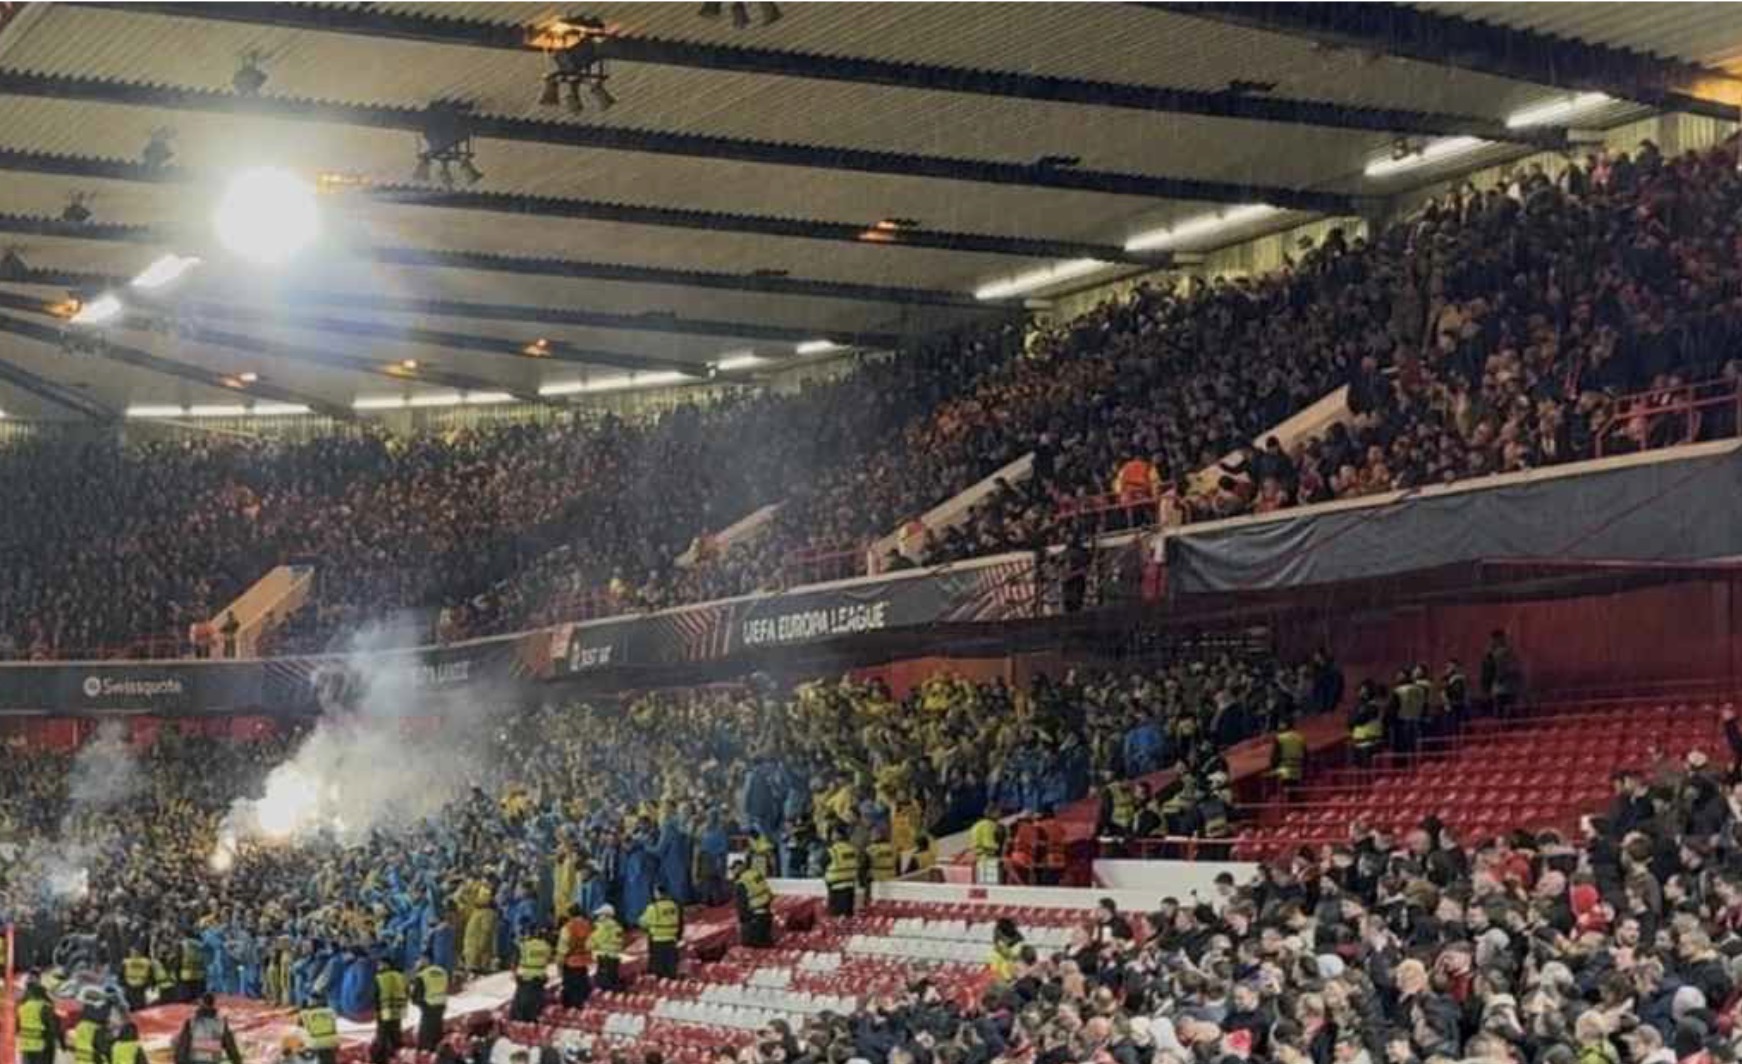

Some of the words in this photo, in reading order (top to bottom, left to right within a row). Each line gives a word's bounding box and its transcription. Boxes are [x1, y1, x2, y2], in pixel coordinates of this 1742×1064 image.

[743, 618, 776, 644] UEFA
[778, 610, 829, 641] EUROPA
[831, 602, 887, 632] LEAGUE
[103, 678, 182, 698] Swissquote
